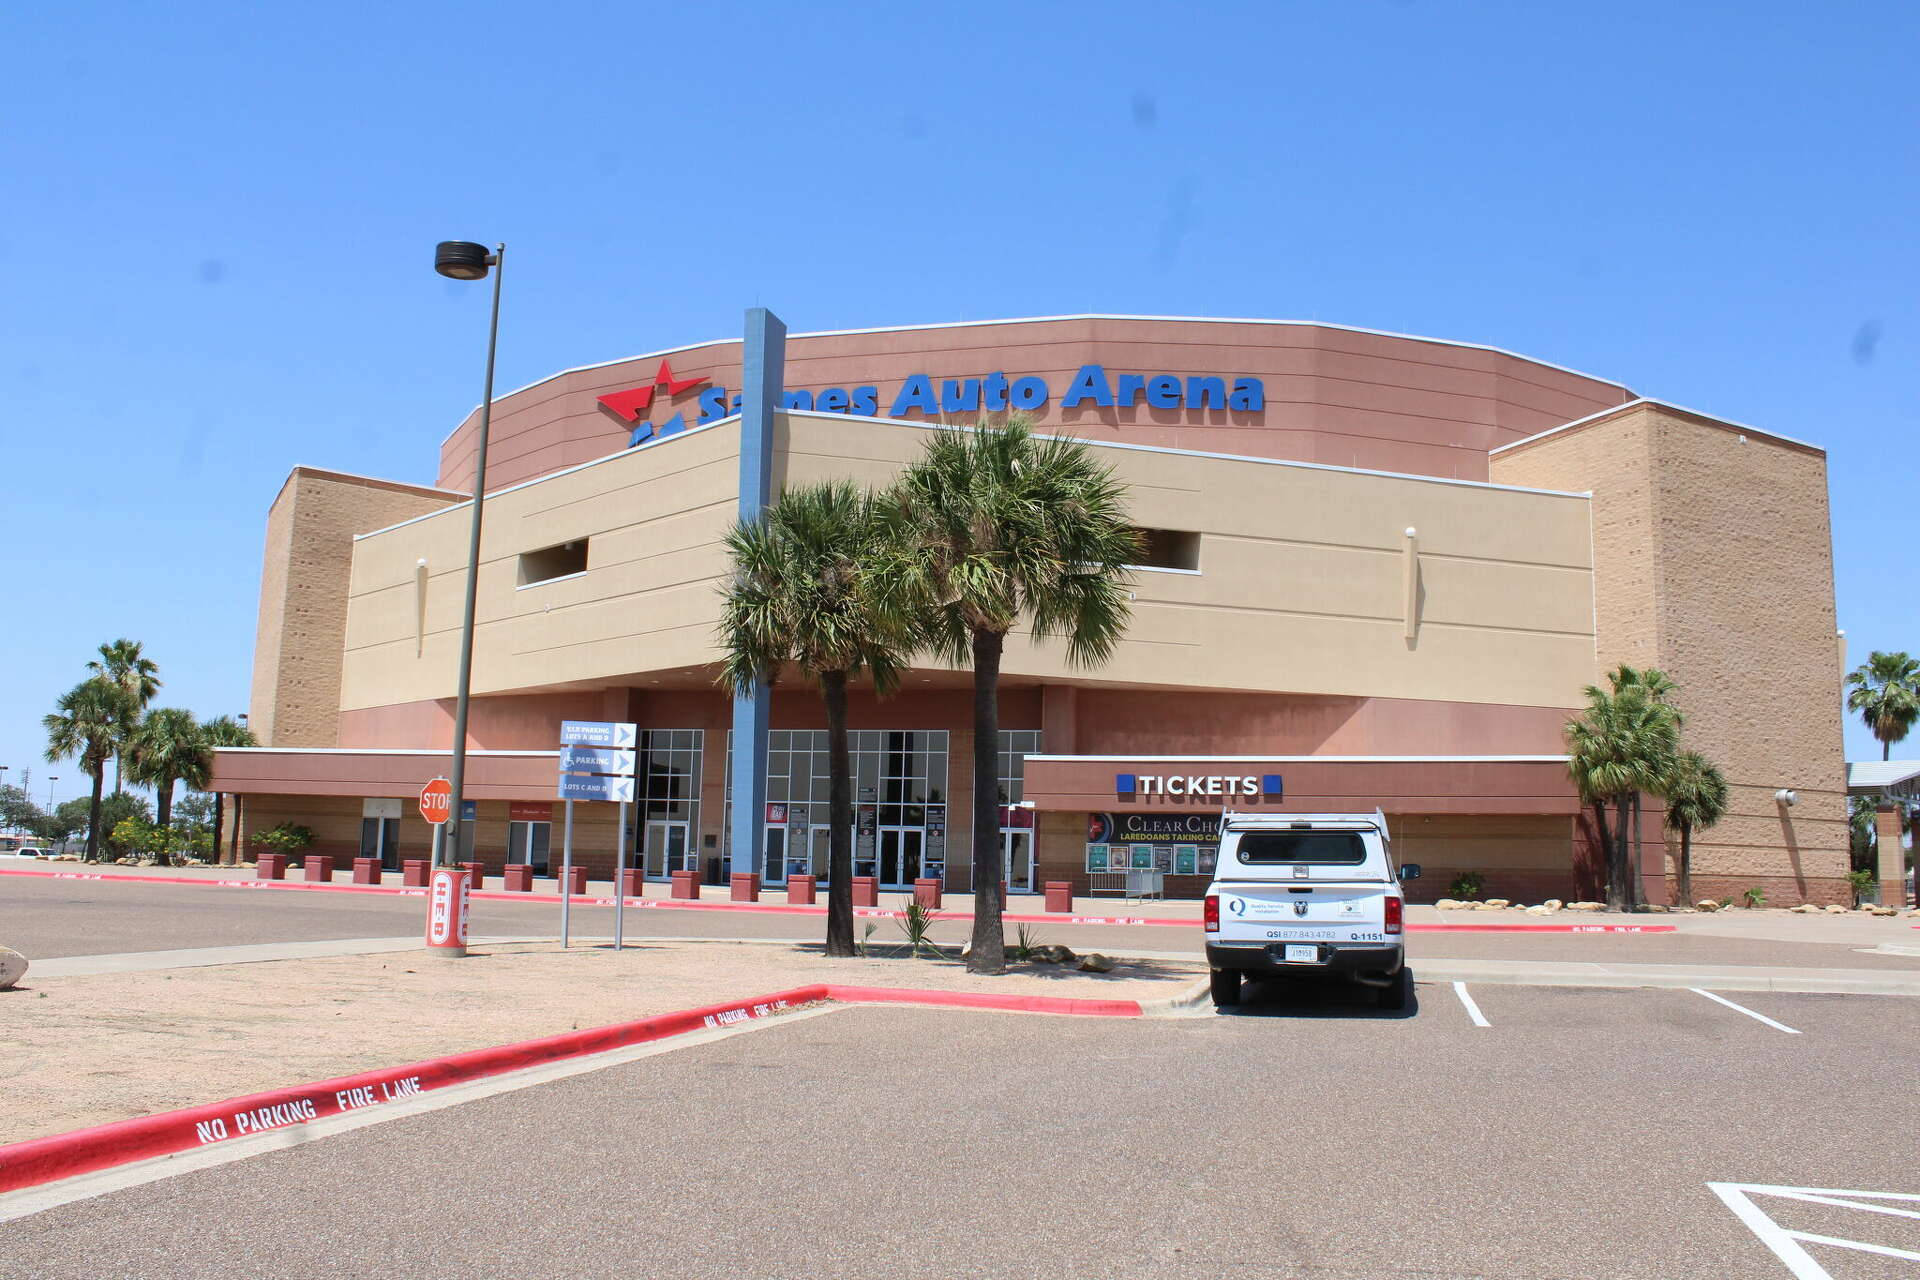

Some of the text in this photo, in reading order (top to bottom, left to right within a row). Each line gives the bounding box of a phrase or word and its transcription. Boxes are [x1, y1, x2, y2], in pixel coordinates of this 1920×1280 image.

[888, 371, 1049, 417] Auto
[1059, 364, 1265, 412] Arena
[576, 757, 609, 765] PARKING
[1139, 775, 1259, 795] TICKETS
[1127, 815, 1182, 832] CLEAR
[1120, 833, 1170, 841] LAREDOANS
[1266, 930, 1281, 939] QSI
[1350, 932, 1383, 941] Q-1151
[717, 1008, 750, 1025] PARKING
[195, 1076, 425, 1144] NO PARKING FIRE LANE
